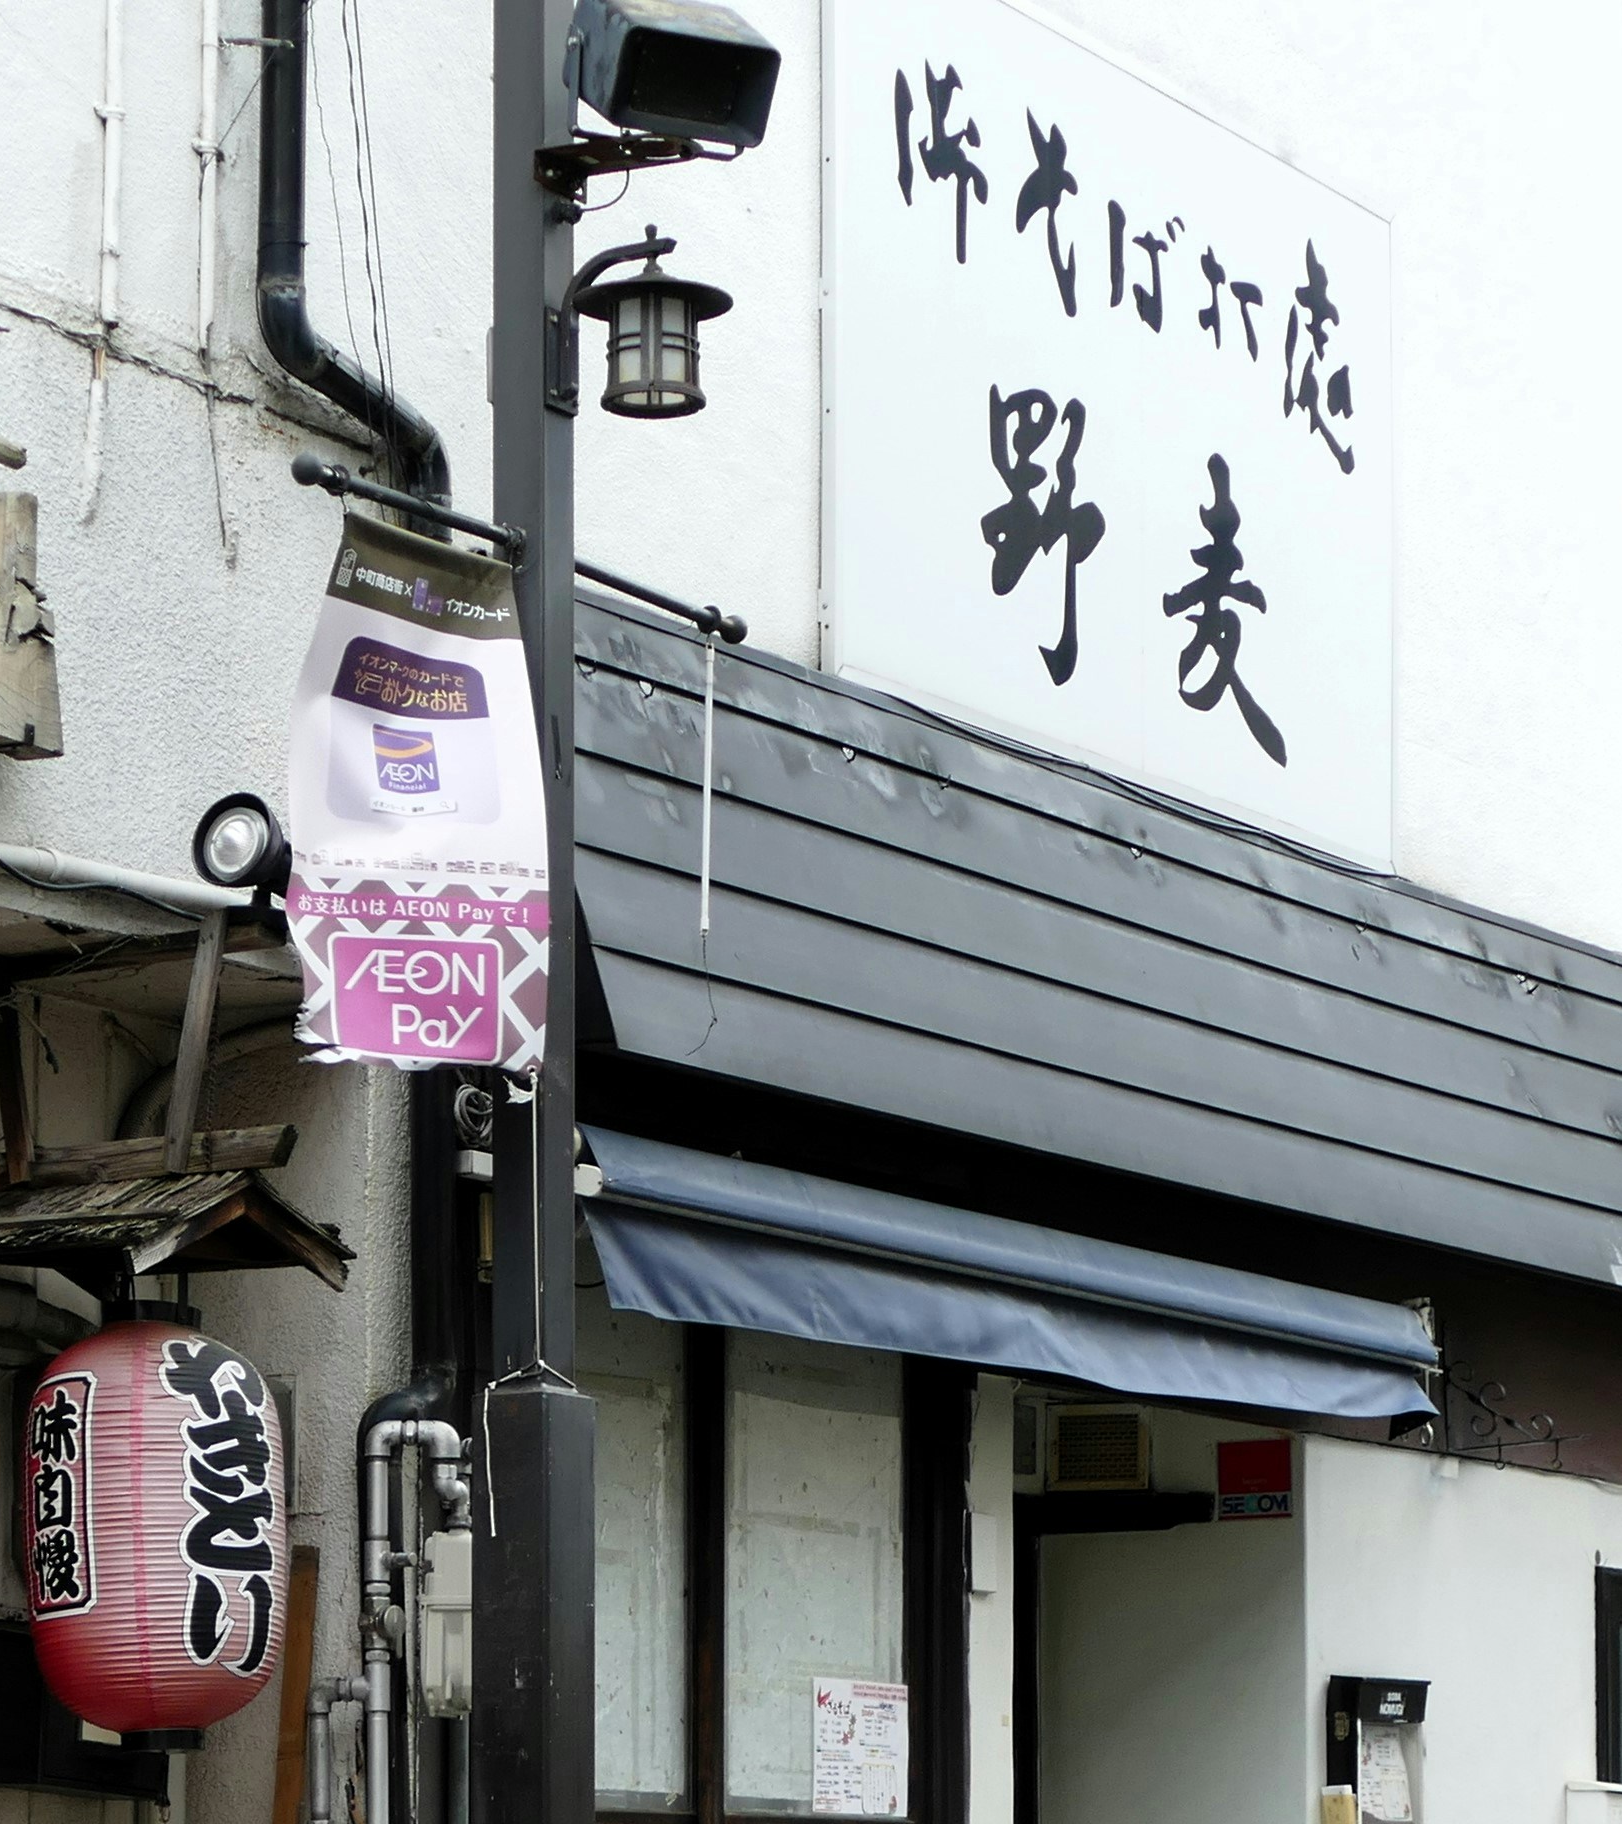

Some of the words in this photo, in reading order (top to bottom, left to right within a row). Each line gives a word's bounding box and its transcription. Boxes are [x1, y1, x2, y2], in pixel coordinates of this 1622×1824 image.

[355, 566, 404, 596] 中町商店街
[445, 598, 511, 622] イオンカード
[979, 382, 1287, 768] 野麦
[359, 652, 465, 688] イオンマークのカードで
[381, 677, 468, 713] おトクなお店
[388, 781, 427, 791] Financial
[297, 893, 387, 916] お支払いは
[392, 902, 450, 918] AEON
[458, 904, 494, 923] Pay
[343, 948, 486, 996] AEON
[390, 1003, 484, 1050] Pay
[30, 1385, 82, 1603] 味自慢
[157, 1334, 277, 1679] やきとり
[1221, 1494, 1288, 1514] SECOM
